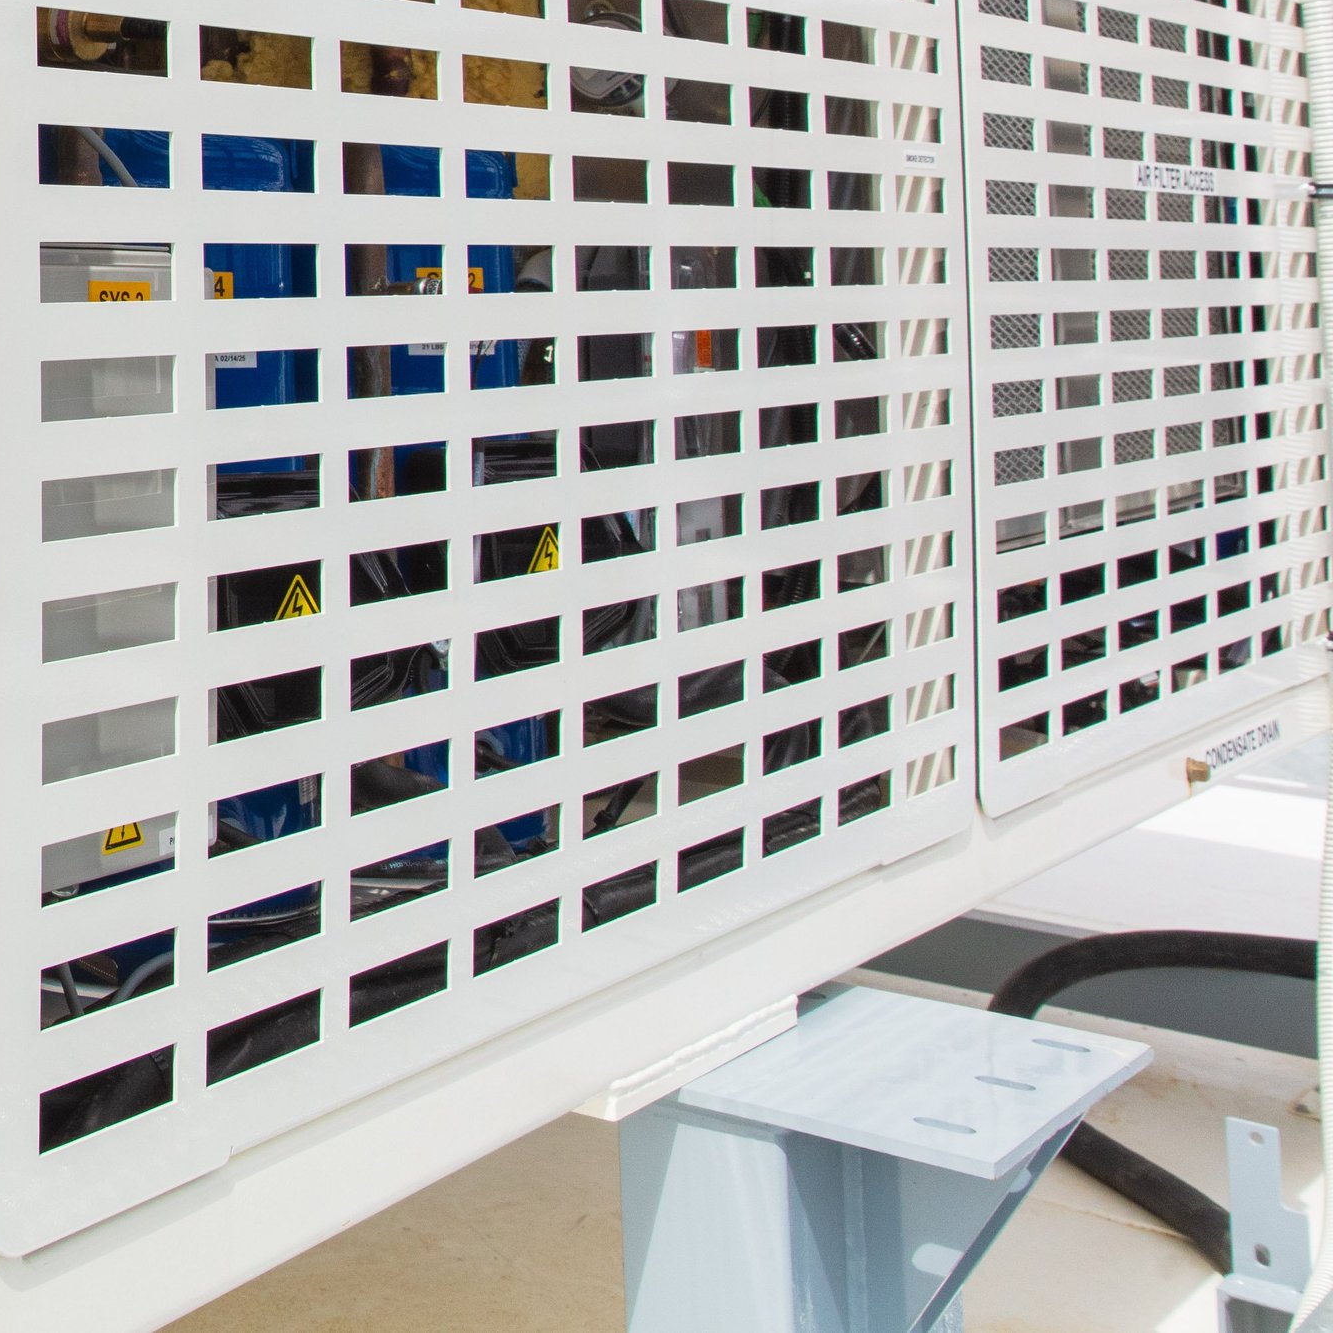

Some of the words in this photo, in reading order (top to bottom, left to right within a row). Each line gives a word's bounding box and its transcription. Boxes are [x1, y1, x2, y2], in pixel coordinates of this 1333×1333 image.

[1137, 165, 1150, 183] AIR
[1153, 167, 1181, 189] FILTER
[1183, 171, 1215, 192] ACCESS
[214, 276, 225, 296] 4
[1205, 730, 1255, 769] CONDENSATE
[1258, 718, 1280, 747] DRAIN
